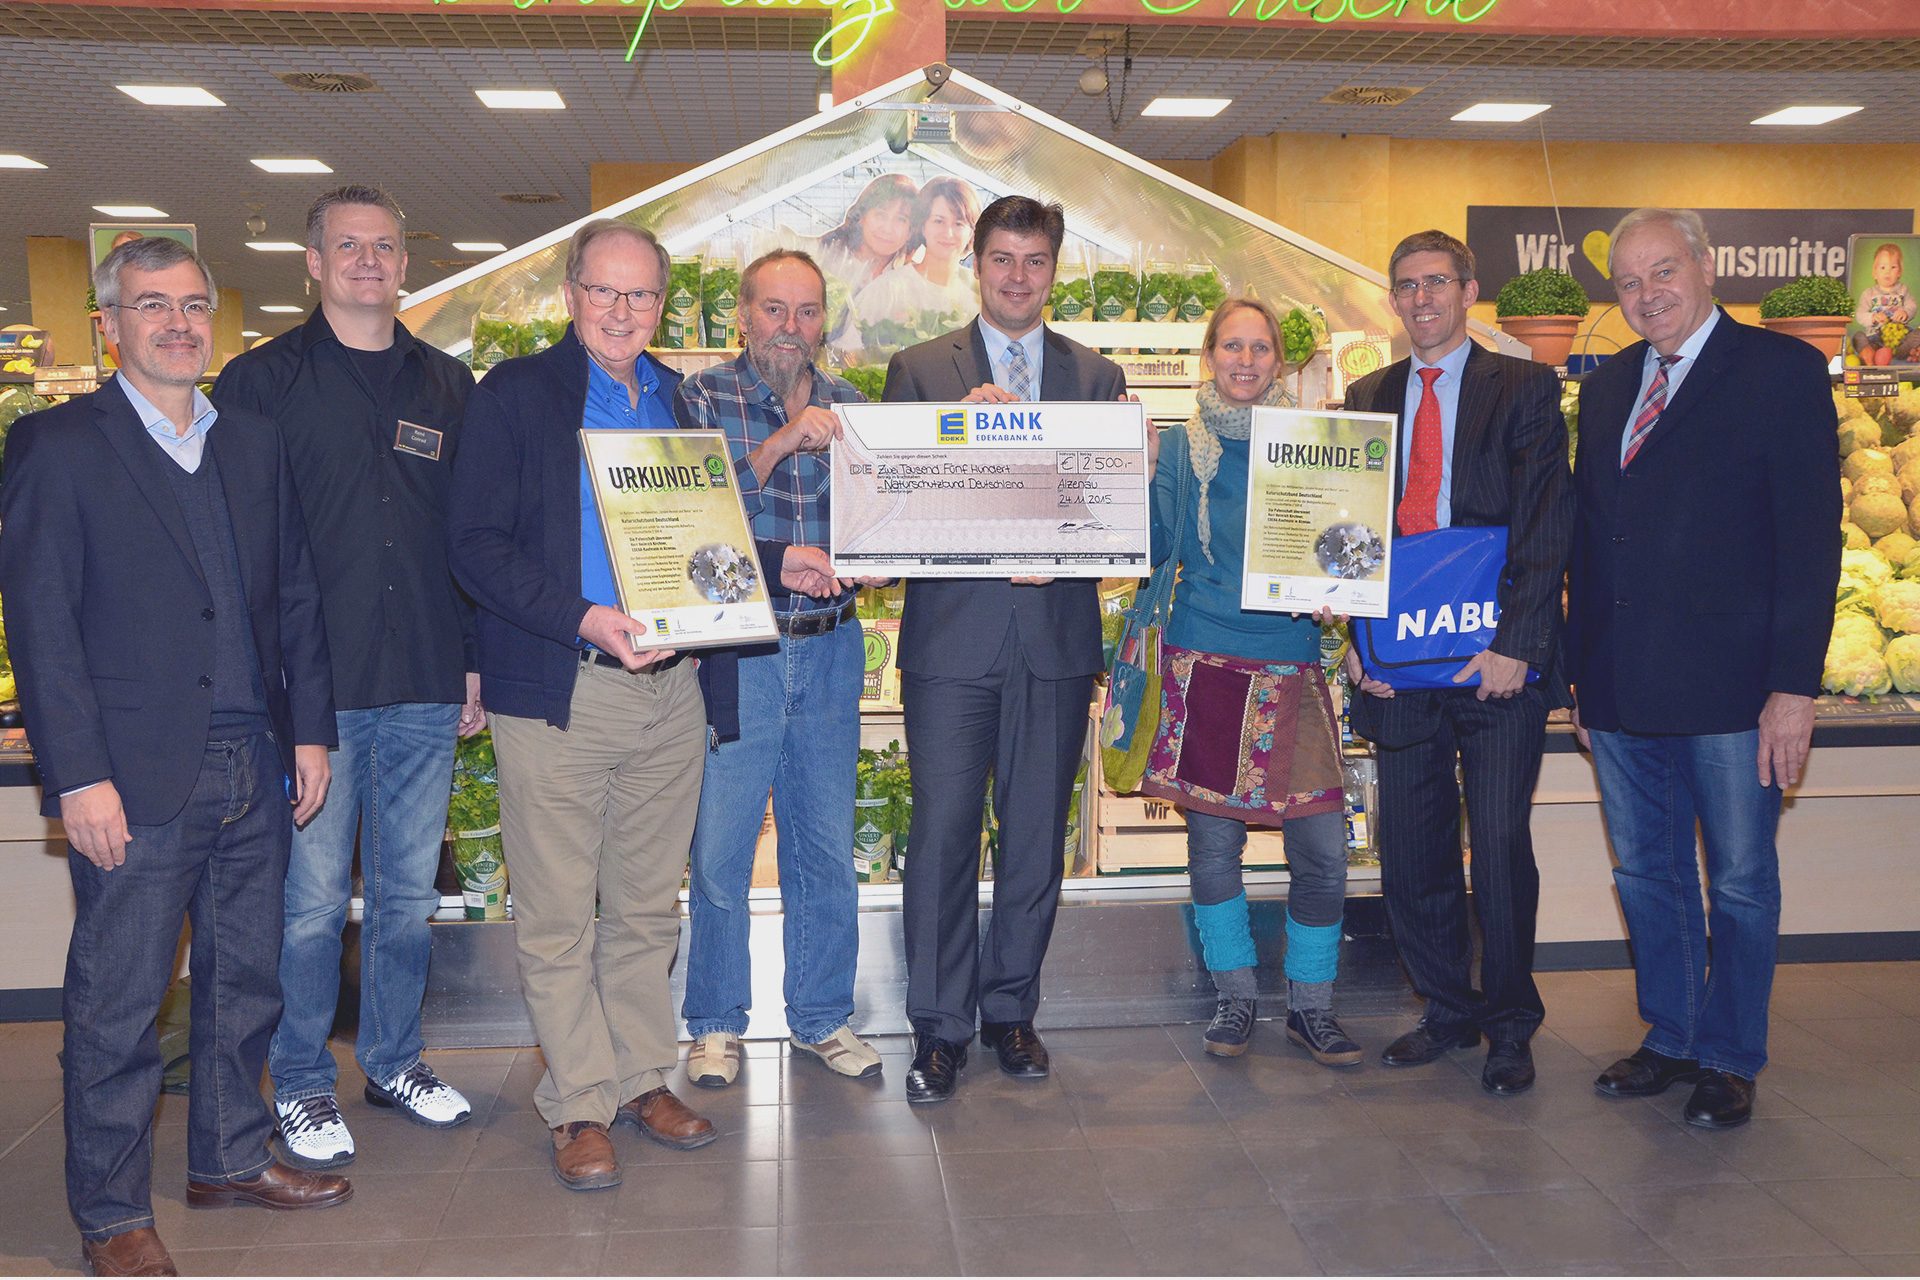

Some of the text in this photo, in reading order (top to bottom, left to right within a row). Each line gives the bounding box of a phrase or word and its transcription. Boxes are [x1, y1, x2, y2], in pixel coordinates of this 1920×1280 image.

[1515, 234, 1575, 275] Wir
[975, 412, 1042, 430] BANK
[1061, 456, 1074, 470] €
[1267, 443, 1360, 468] URKUNDE
[608, 466, 705, 489] URKUNDE
[850, 464, 872, 475] DE
[900, 463, 939, 475] Tausend
[971, 463, 1010, 475] Hundert
[884, 478, 1024, 490] Naturschutzbund Deutschland
[1144, 803, 1170, 820] Wir
